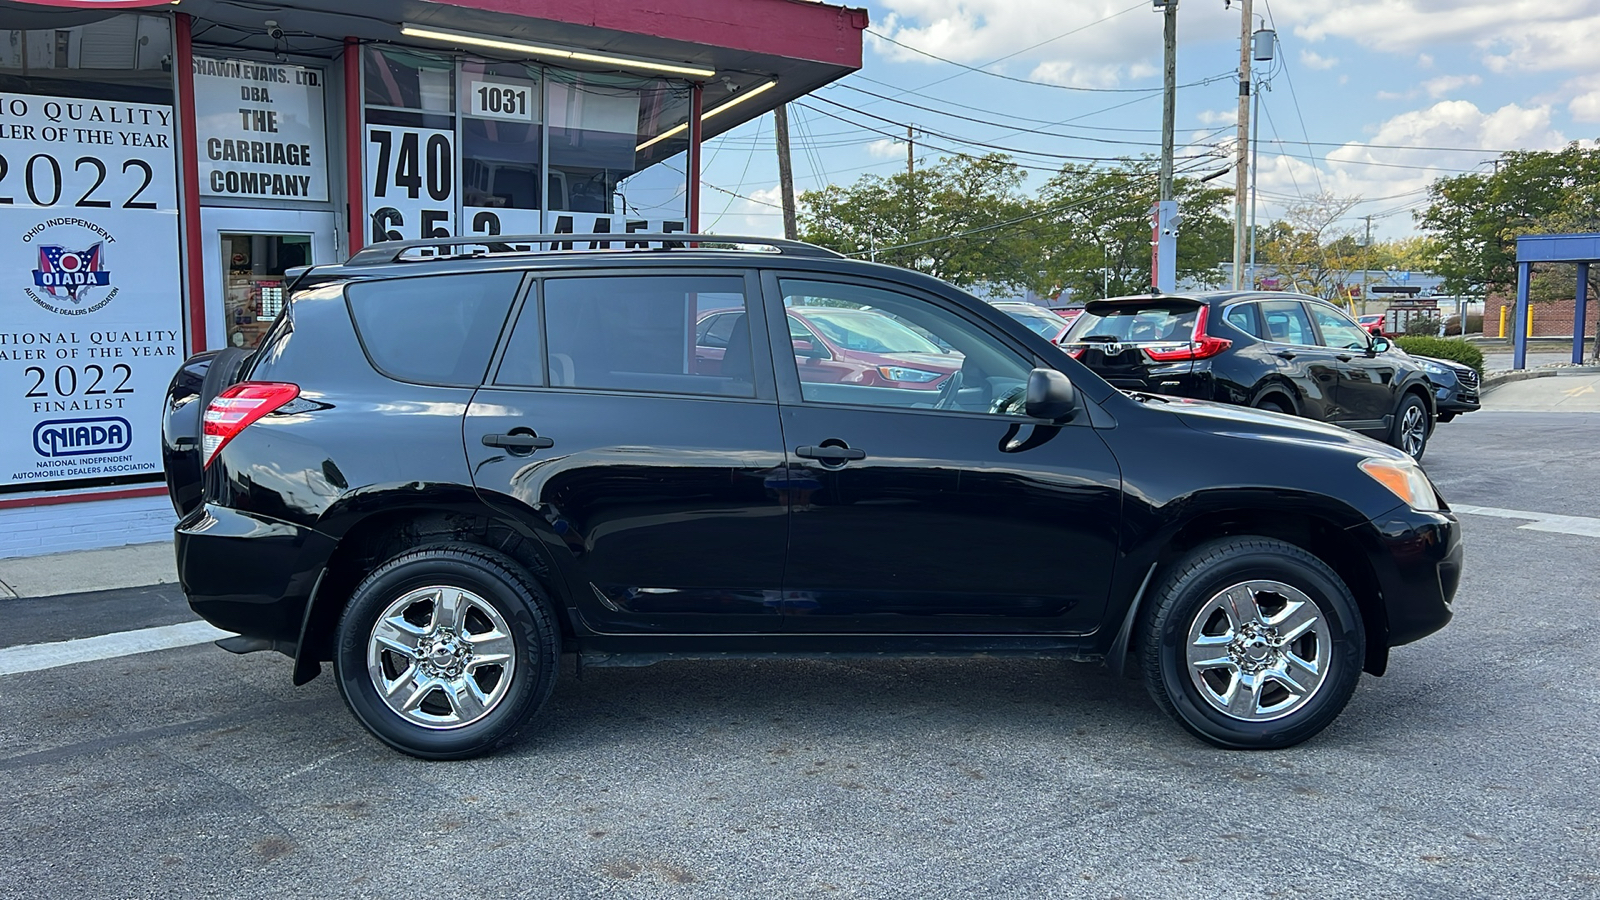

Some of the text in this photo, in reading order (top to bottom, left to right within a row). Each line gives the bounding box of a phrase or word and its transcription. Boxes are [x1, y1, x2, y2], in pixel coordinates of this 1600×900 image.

[193, 60, 240, 79] SHAWN
[296, 70, 321, 87] LTD.
[241, 86, 273, 103] DBA.
[477, 86, 526, 115] 1031
[44, 102, 170, 126] QUALITY
[239, 108, 278, 133] THE
[42, 127, 68, 142] OF
[74, 129, 114, 145] THE
[119, 132, 169, 148] YEAR
[207, 137, 311, 166] CARRIAGE
[369, 129, 451, 201] 740
[210, 169, 311, 197] COMPANY
[22, 217, 117, 244] OHIO INDEPENDENT
[42, 272, 98, 285] OIADA
[24, 286, 120, 316] AUTOMOBILE DEALERS ASSOCIATION
[90, 330, 178, 345] QUALITY
[56, 348, 79, 359] OF
[88, 347, 123, 358] THE
[131, 346, 177, 357] YEAR
[24, 363, 135, 398] 2022
[33, 398, 126, 413] FINALIST
[42, 424, 123, 450] NIADA
[12, 462, 156, 480] AUTOMOBILE DEALERS ASSOCIATION
[36, 455, 133, 468] NATIONAL INDEPENDENT
